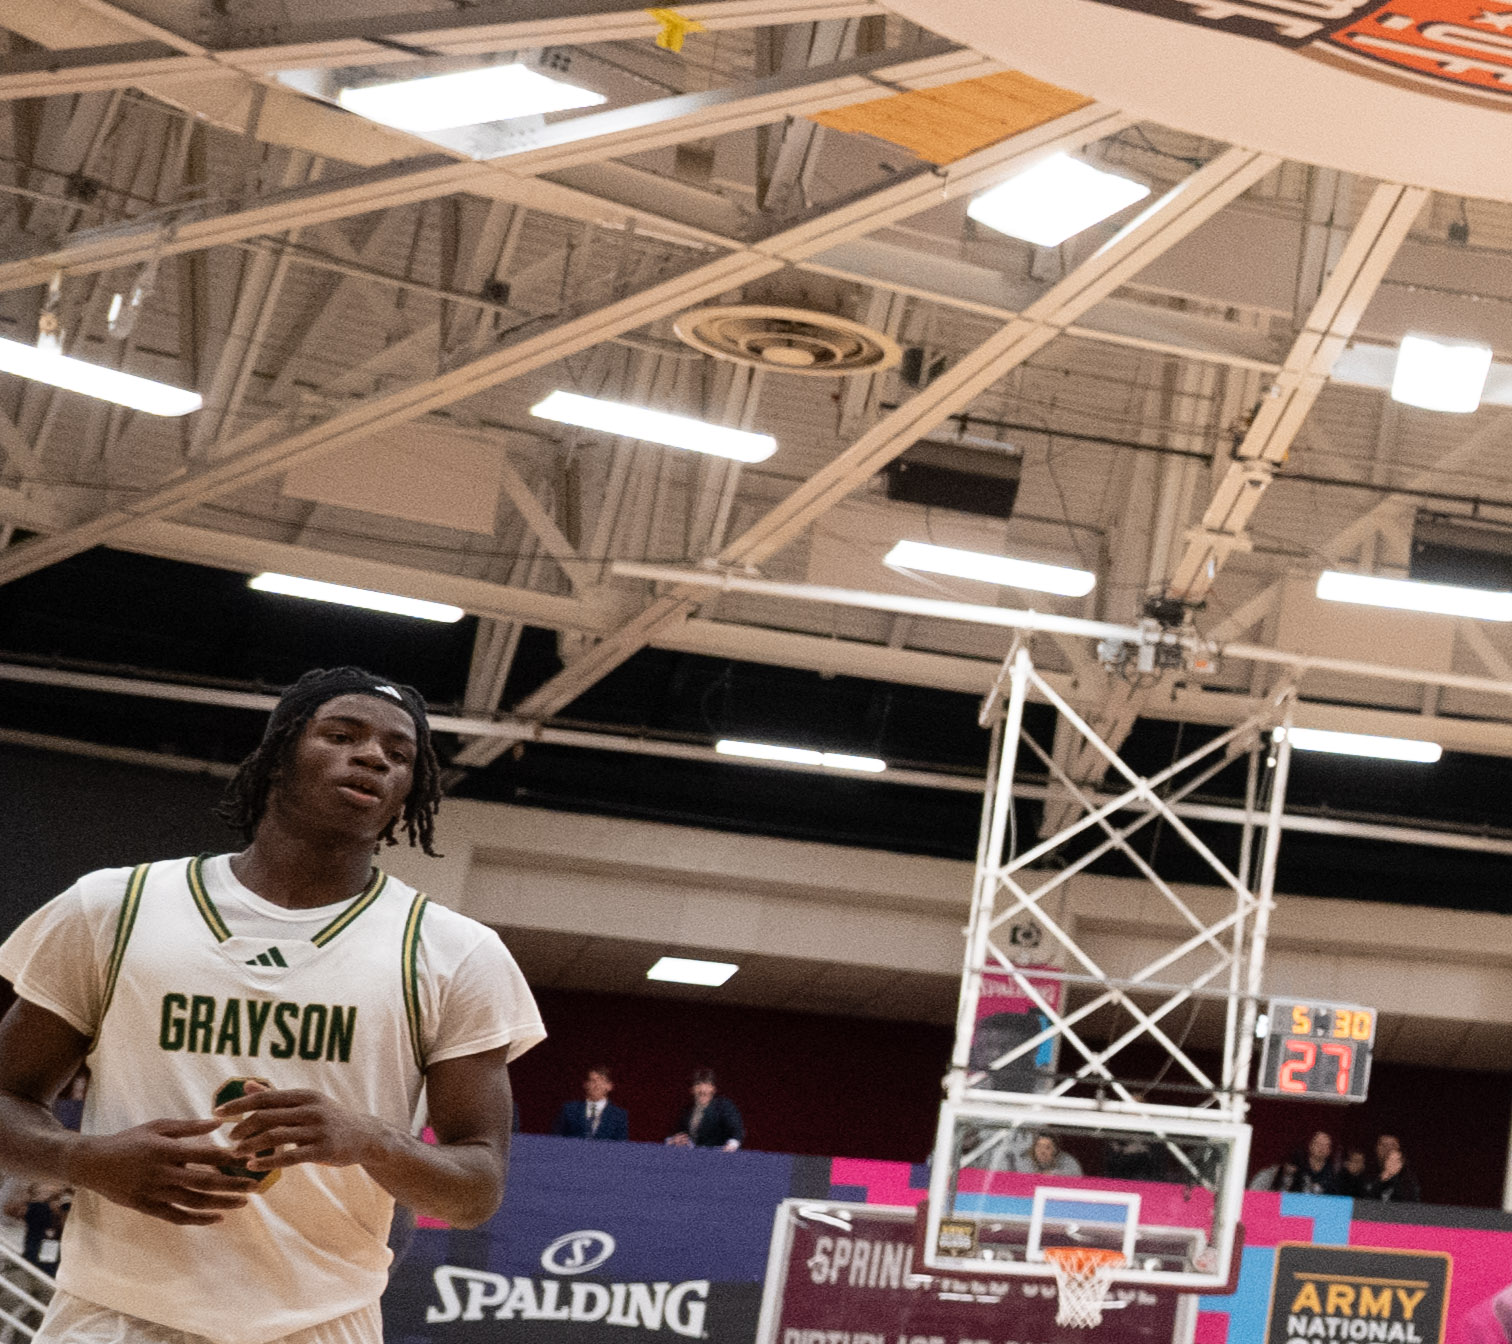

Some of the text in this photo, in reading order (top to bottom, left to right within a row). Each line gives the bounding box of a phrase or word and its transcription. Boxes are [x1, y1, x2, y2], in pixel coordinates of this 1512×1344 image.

[159, 993, 358, 1064] GRAYSON
[1279, 1039, 1352, 1096] 27
[426, 1266, 709, 1339] SPALDING
[1291, 1283, 1428, 1318] ARMY
[1287, 1316, 1422, 1344] NATIONAL
